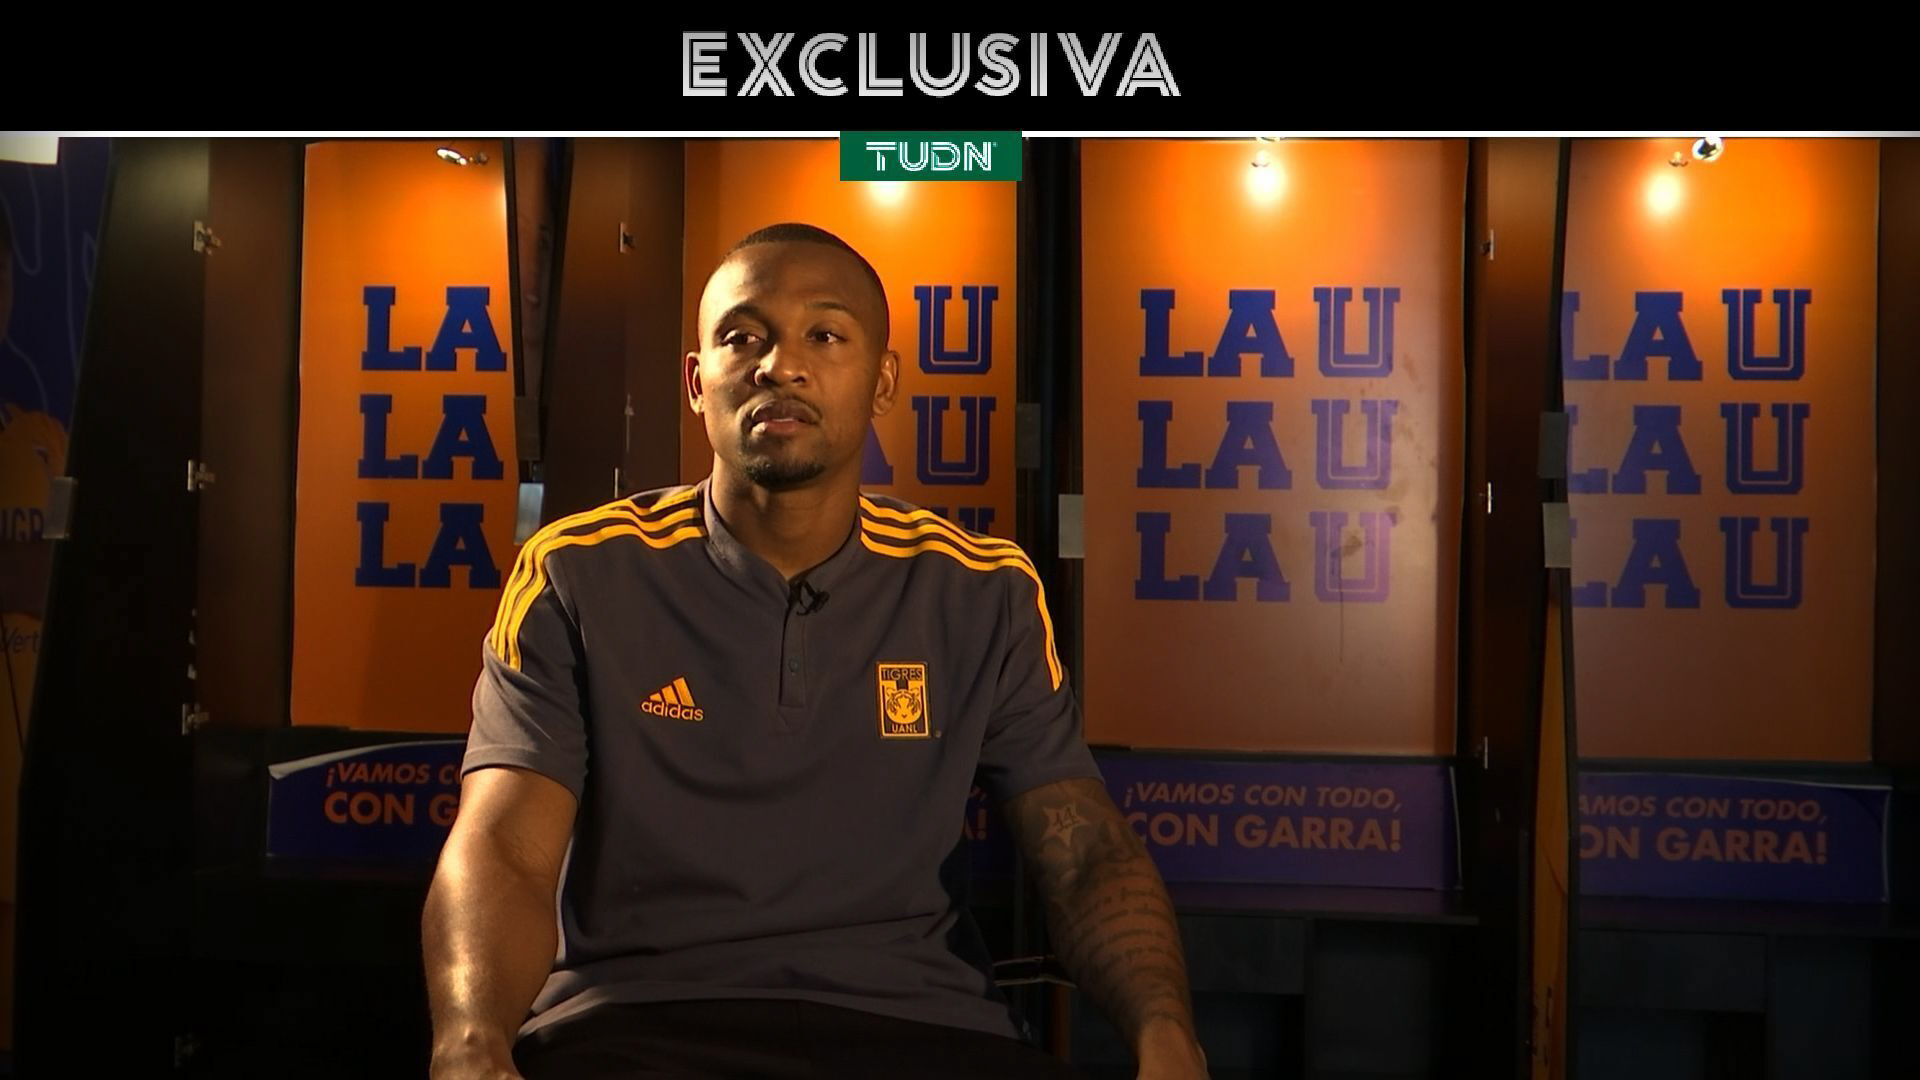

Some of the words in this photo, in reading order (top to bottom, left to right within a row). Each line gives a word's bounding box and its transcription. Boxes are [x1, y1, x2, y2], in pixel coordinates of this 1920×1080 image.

[361, 286, 507, 371] LA
[914, 286, 998, 375] U
[1139, 289, 1295, 377] LA
[1313, 287, 1401, 377] U
[1722, 289, 1812, 380] U
[358, 394, 503, 480] LA
[911, 396, 996, 485] U
[1137, 401, 1292, 489] LA
[1311, 400, 1398, 489] U
[1720, 403, 1810, 494] U
[355, 502, 501, 588] LA
[1135, 512, 1290, 601] LA
[1309, 511, 1397, 602] U
[1719, 517, 1809, 609] U
[641, 700, 704, 722] adidas
[882, 668, 923, 681] TIGRES
[892, 723, 918, 733] UANL
[323, 791, 415, 825] CON
[326, 762, 430, 788] ¡VAMOS
[1124, 781, 1235, 808] ¡VAMOS
[1245, 785, 1302, 808] CON
[1316, 786, 1403, 814] TODO,
[1666, 797, 1730, 820] CON
[1741, 799, 1828, 824] TODO,
[1127, 812, 1219, 848] CON
[1234, 814, 1402, 853] GARRA!
[1656, 827, 1828, 865] GARRA!
